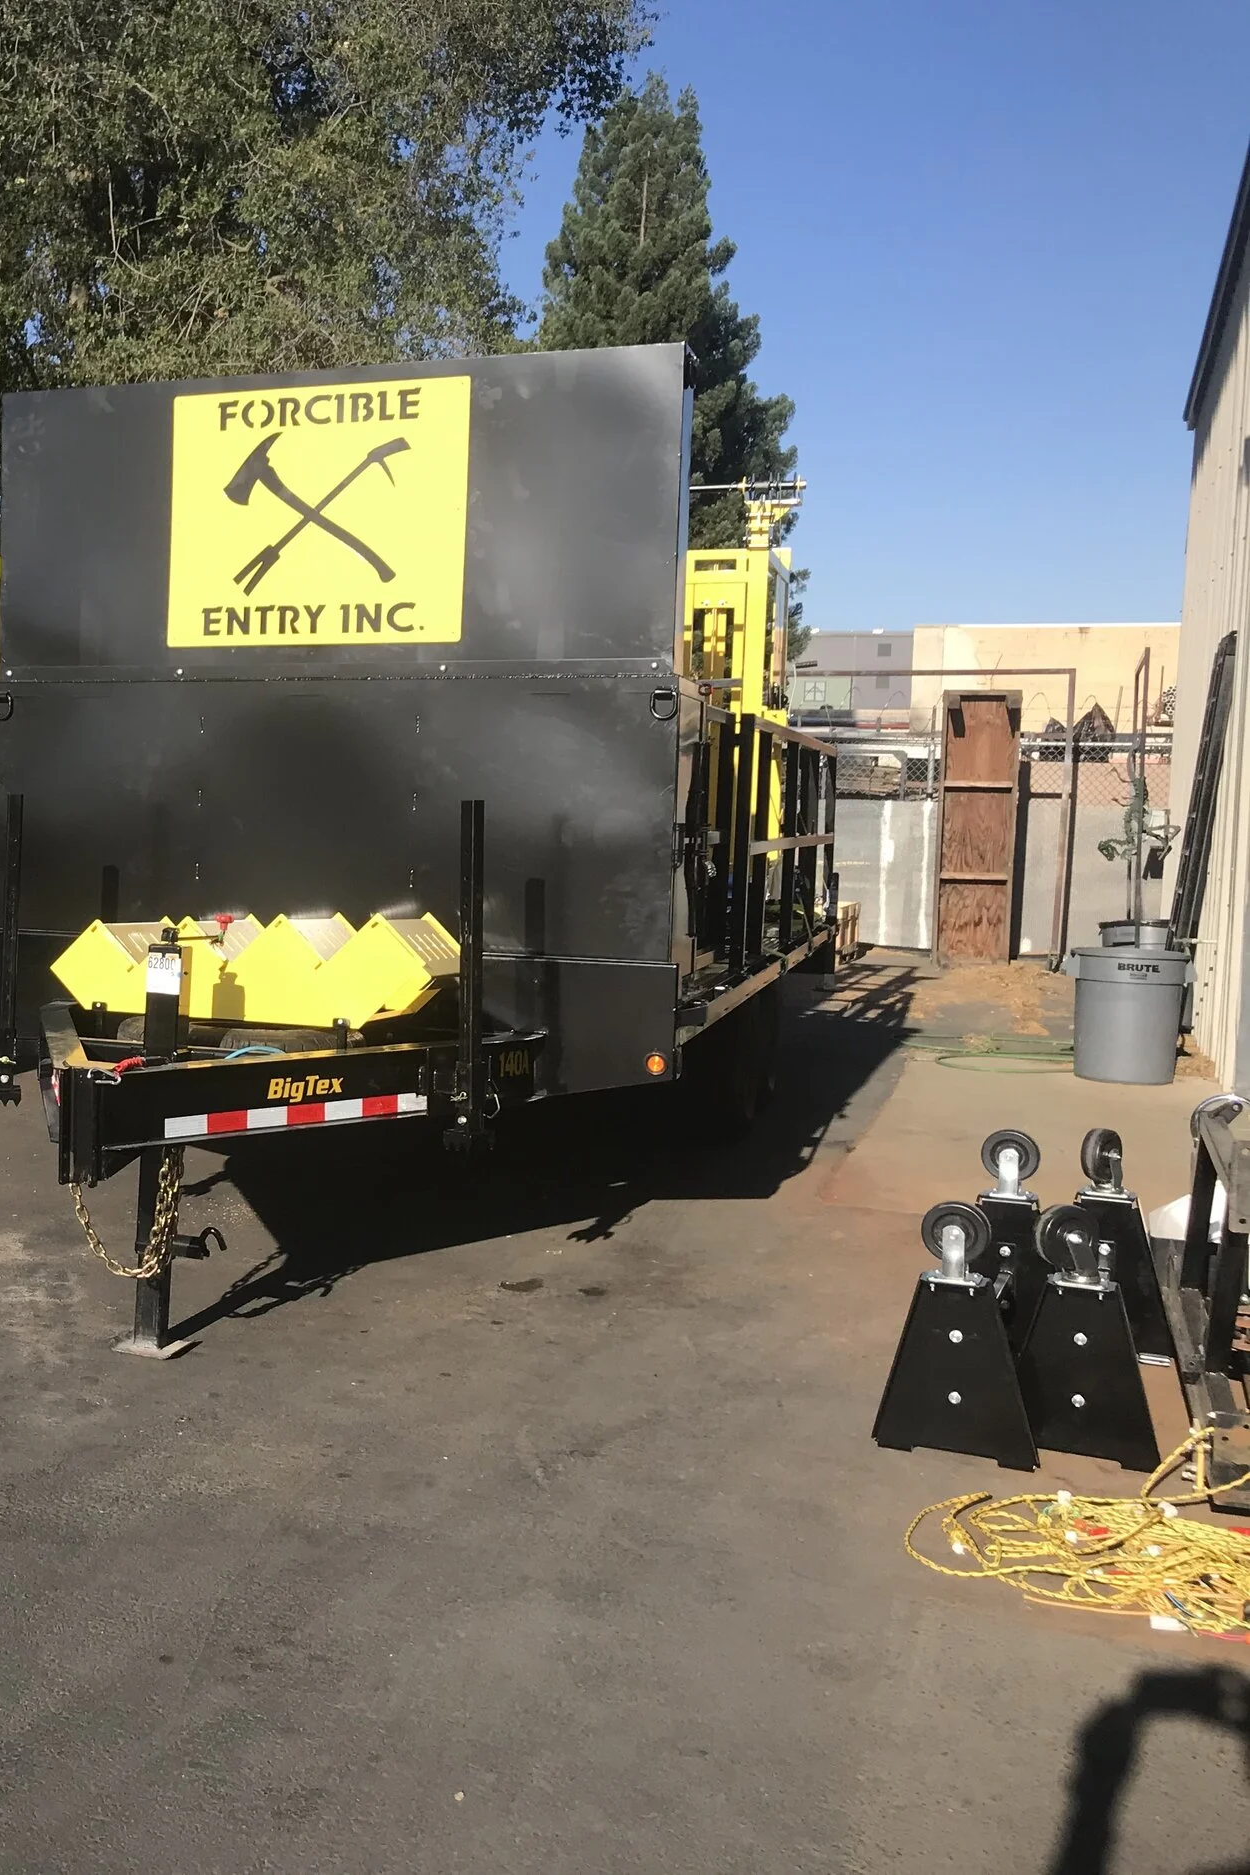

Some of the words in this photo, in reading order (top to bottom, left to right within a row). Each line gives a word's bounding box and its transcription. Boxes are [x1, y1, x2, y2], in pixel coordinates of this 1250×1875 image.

[218, 387, 422, 431] FORCIBLE
[202, 604, 326, 636] ENTRY
[339, 602, 424, 633] INC.
[1117, 962, 1161, 973] BRUTE
[266, 1075, 344, 1103] BigTex
